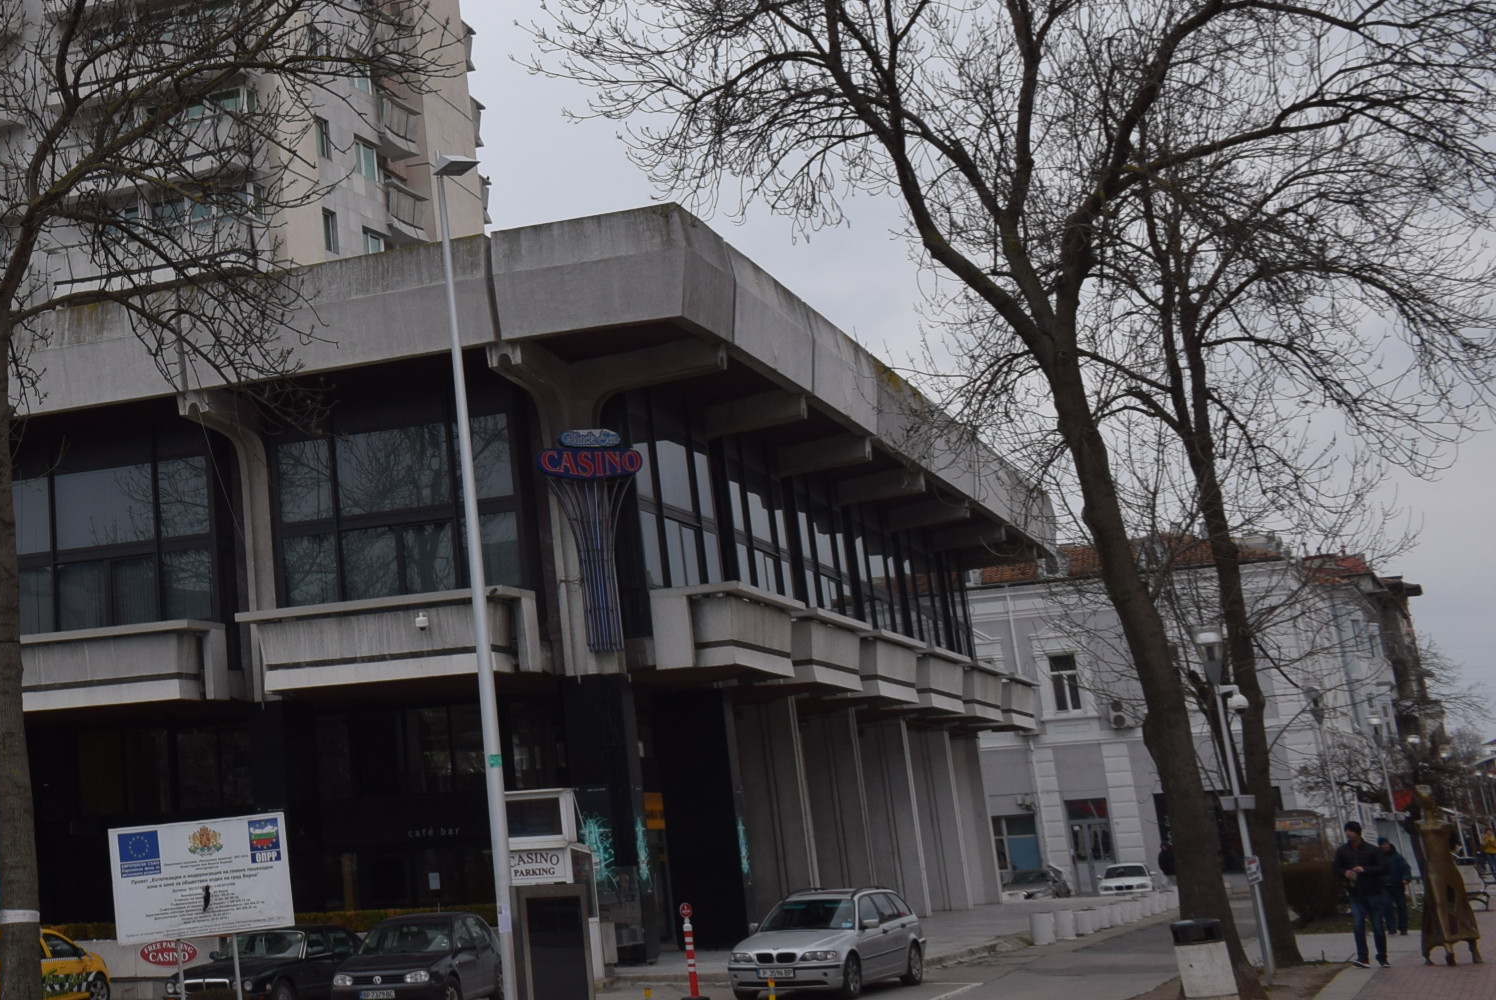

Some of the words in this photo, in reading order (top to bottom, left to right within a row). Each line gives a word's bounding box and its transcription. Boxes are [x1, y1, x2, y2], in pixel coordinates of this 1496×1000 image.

[541, 450, 642, 477] CASINO
[407, 826, 433, 838] café
[440, 826, 461, 837] bar
[255, 851, 277, 862] ОПРР
[509, 852, 560, 868] CASINO
[514, 867, 556, 877] PARKING
[144, 942, 162, 954] FREE
[162, 941, 194, 954] PARING
[149, 951, 189, 962] CASINO
